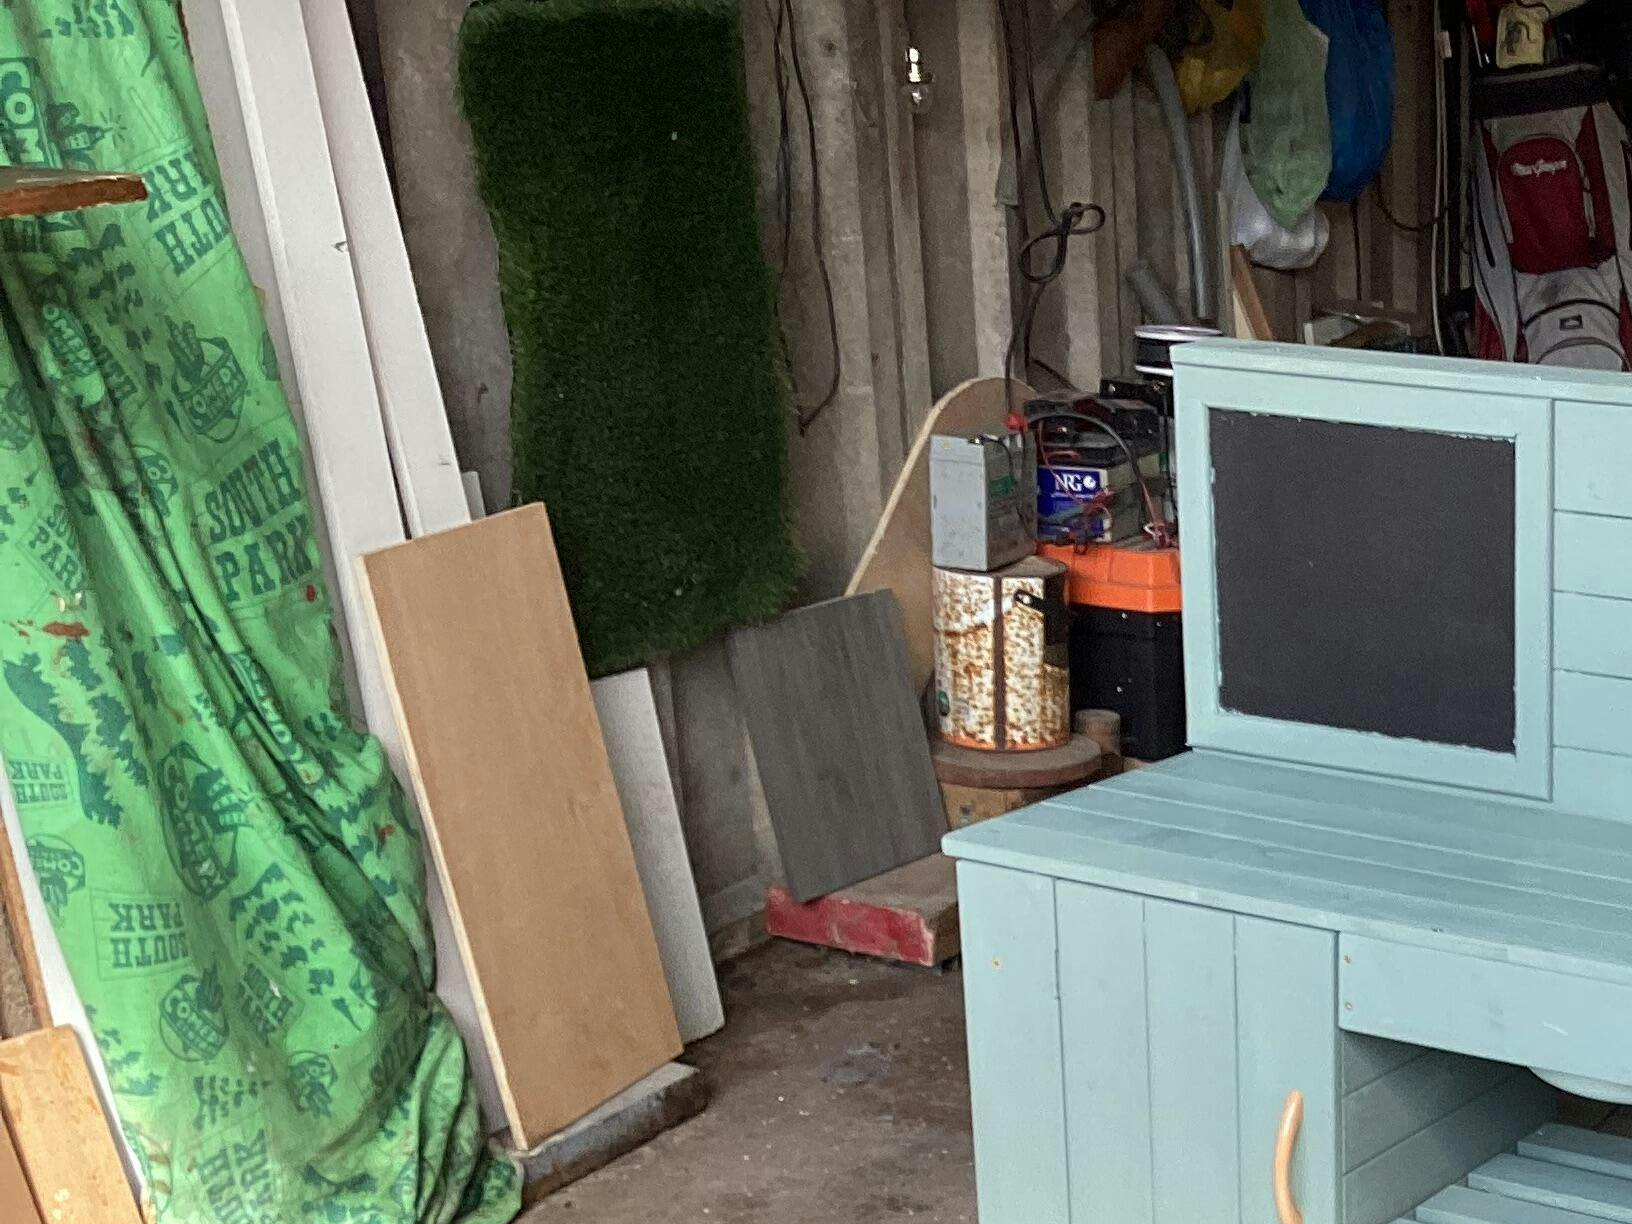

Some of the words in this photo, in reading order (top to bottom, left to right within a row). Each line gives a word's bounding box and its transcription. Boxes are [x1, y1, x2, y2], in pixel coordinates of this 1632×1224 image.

[204, 437, 304, 546] SOUTH
[1054, 472, 1083, 492] NRG
[213, 513, 313, 602] PARK
[107, 901, 185, 932] PARK
[109, 932, 189, 969] SOUTH
